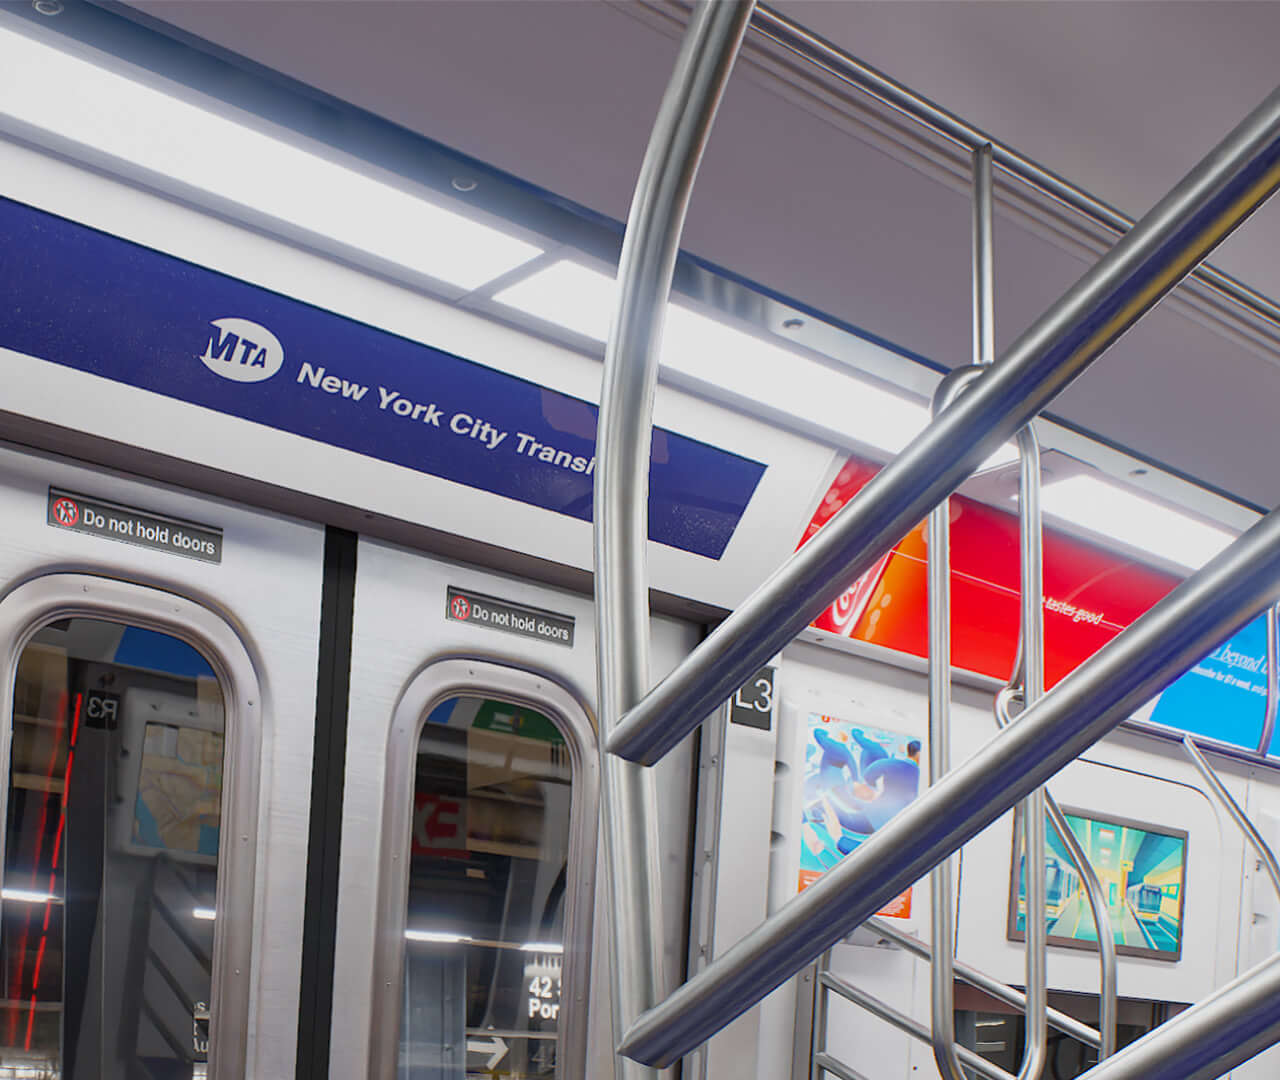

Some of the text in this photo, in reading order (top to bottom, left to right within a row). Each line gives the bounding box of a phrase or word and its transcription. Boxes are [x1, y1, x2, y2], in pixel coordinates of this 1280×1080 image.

[201, 326, 597, 475] MTA New York City Transi
[83, 509, 216, 554] Do not hold doors
[472, 604, 569, 640] Do not hold doors
[736, 679, 772, 712] L3
[528, 976, 552, 998] 42
[528, 998, 560, 1019] Por
